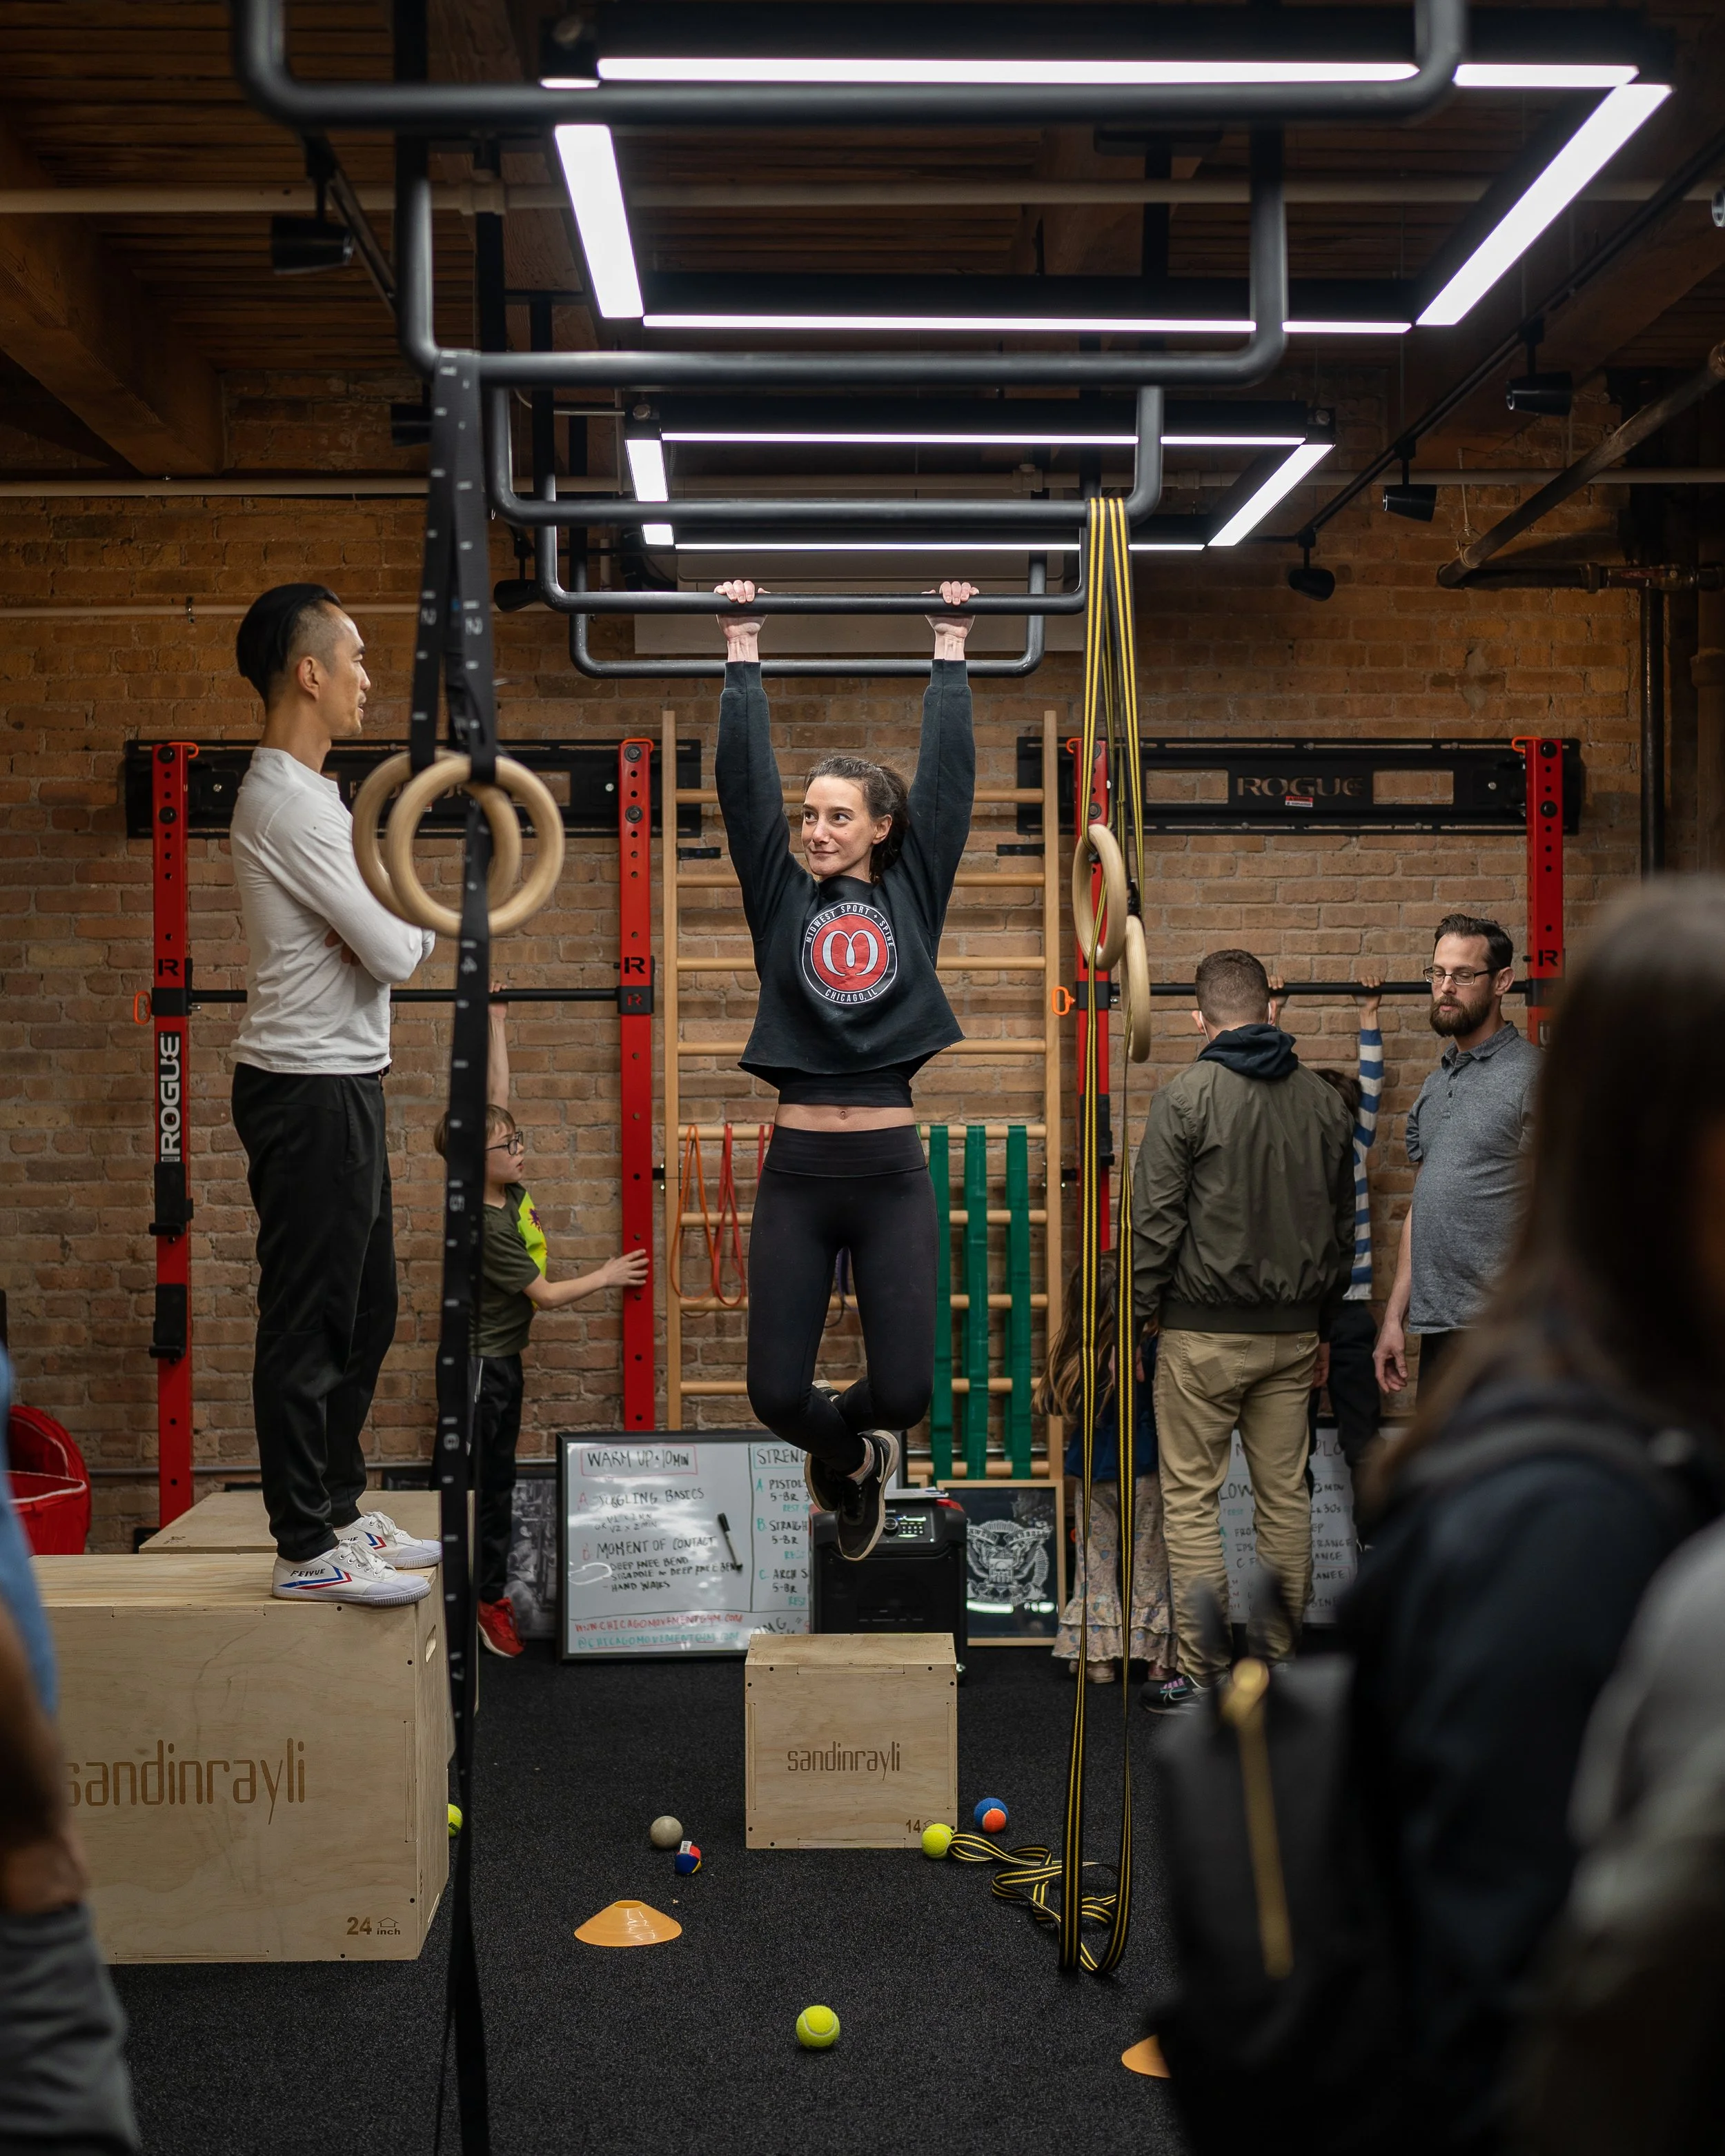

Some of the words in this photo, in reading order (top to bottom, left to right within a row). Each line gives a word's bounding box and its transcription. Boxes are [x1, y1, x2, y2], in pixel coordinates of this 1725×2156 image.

[465, 616, 482, 635] 2
[1237, 777, 1363, 796] ROGUE
[805, 910, 836, 943] MIDWEST
[840, 904, 870, 915] SPORT
[878, 920, 895, 947] SPINE
[825, 989, 867, 1002] CHICAGO,
[867, 988, 878, 998] IL
[160, 1036, 181, 1155] ROGUE
[587, 1450, 632, 1469] WARM
[637, 1450, 653, 1468] UP
[598, 1492, 658, 1509] JUGGLING
[664, 1487, 704, 1503] BASICS
[596, 1540, 649, 1560] MOMENT
[653, 1538, 667, 1552] OF
[672, 1536, 718, 1551] CONTACT
[290, 1568, 326, 1577] FEIYUE
[610, 1559, 634, 1572] DEEP
[663, 1556, 689, 1567] BEND
[669, 1565, 693, 1576] DEEP
[611, 1582, 638, 1593] HAND
[787, 1741, 900, 1781] sandinrayli
[62, 1737, 306, 1825] sandinrayli
[905, 1819, 921, 1834] 14
[346, 1916, 373, 1935] 24
